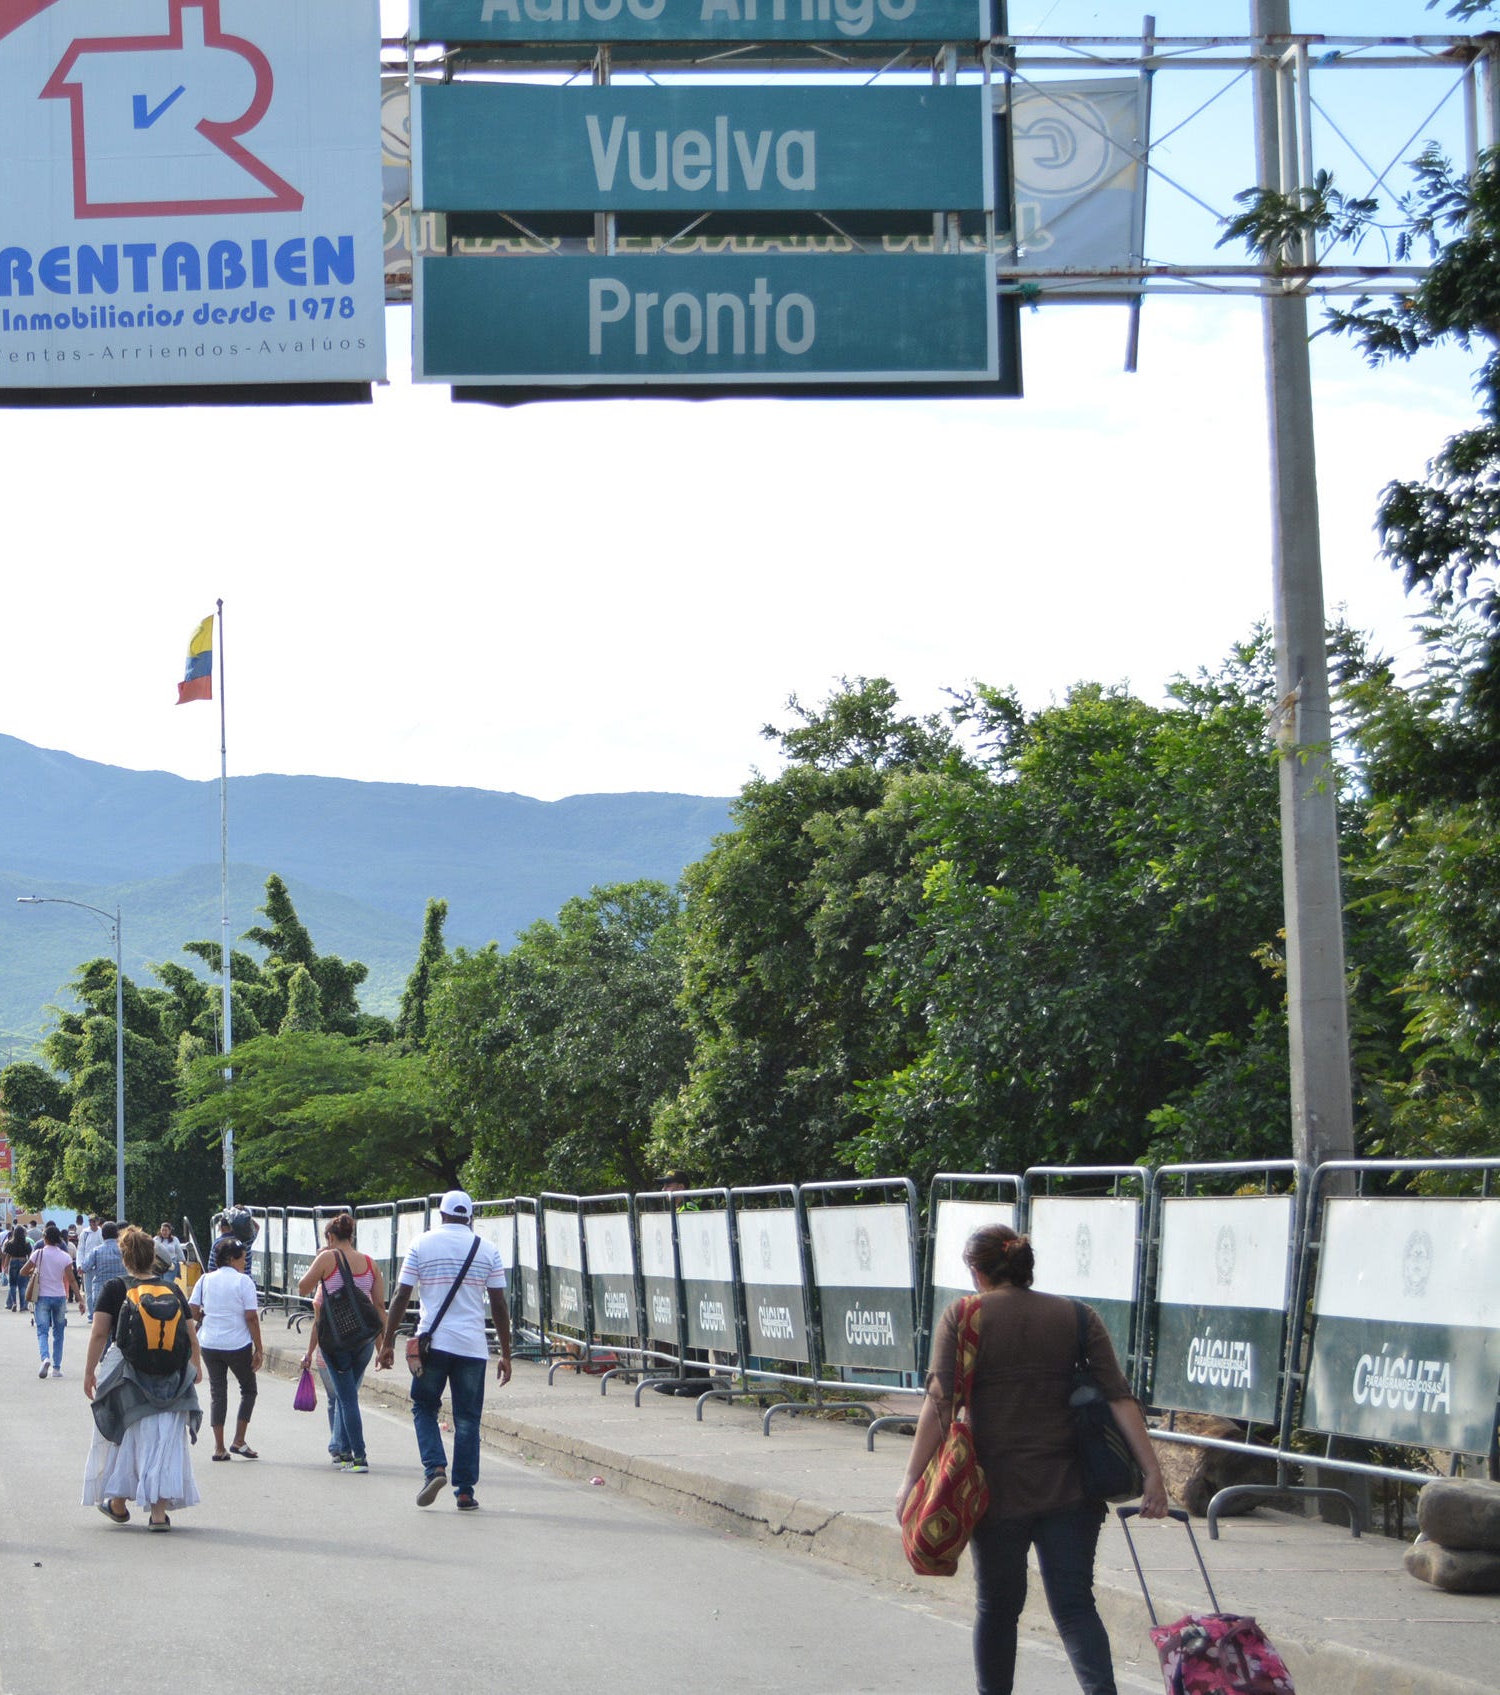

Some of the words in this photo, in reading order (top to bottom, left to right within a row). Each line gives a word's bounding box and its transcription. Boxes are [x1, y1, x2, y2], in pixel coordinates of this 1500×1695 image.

[585, 115, 816, 192] Vuelva
[3, 304, 185, 332] Inmobiliarios
[193, 301, 276, 326] desde
[288, 296, 356, 322] 1978
[587, 277, 816, 355] Pronto
[758, 1297, 795, 1340] CÚCUTA
[845, 1301, 895, 1346] CÚCUTA
[1186, 1326, 1251, 1389] CÚCUTA
[1352, 1342, 1451, 1415] CÚCUTA
[1364, 1374, 1384, 1388] PARA
[1384, 1375, 1417, 1391] GRANDES
[1417, 1378, 1442, 1395] COSAS
